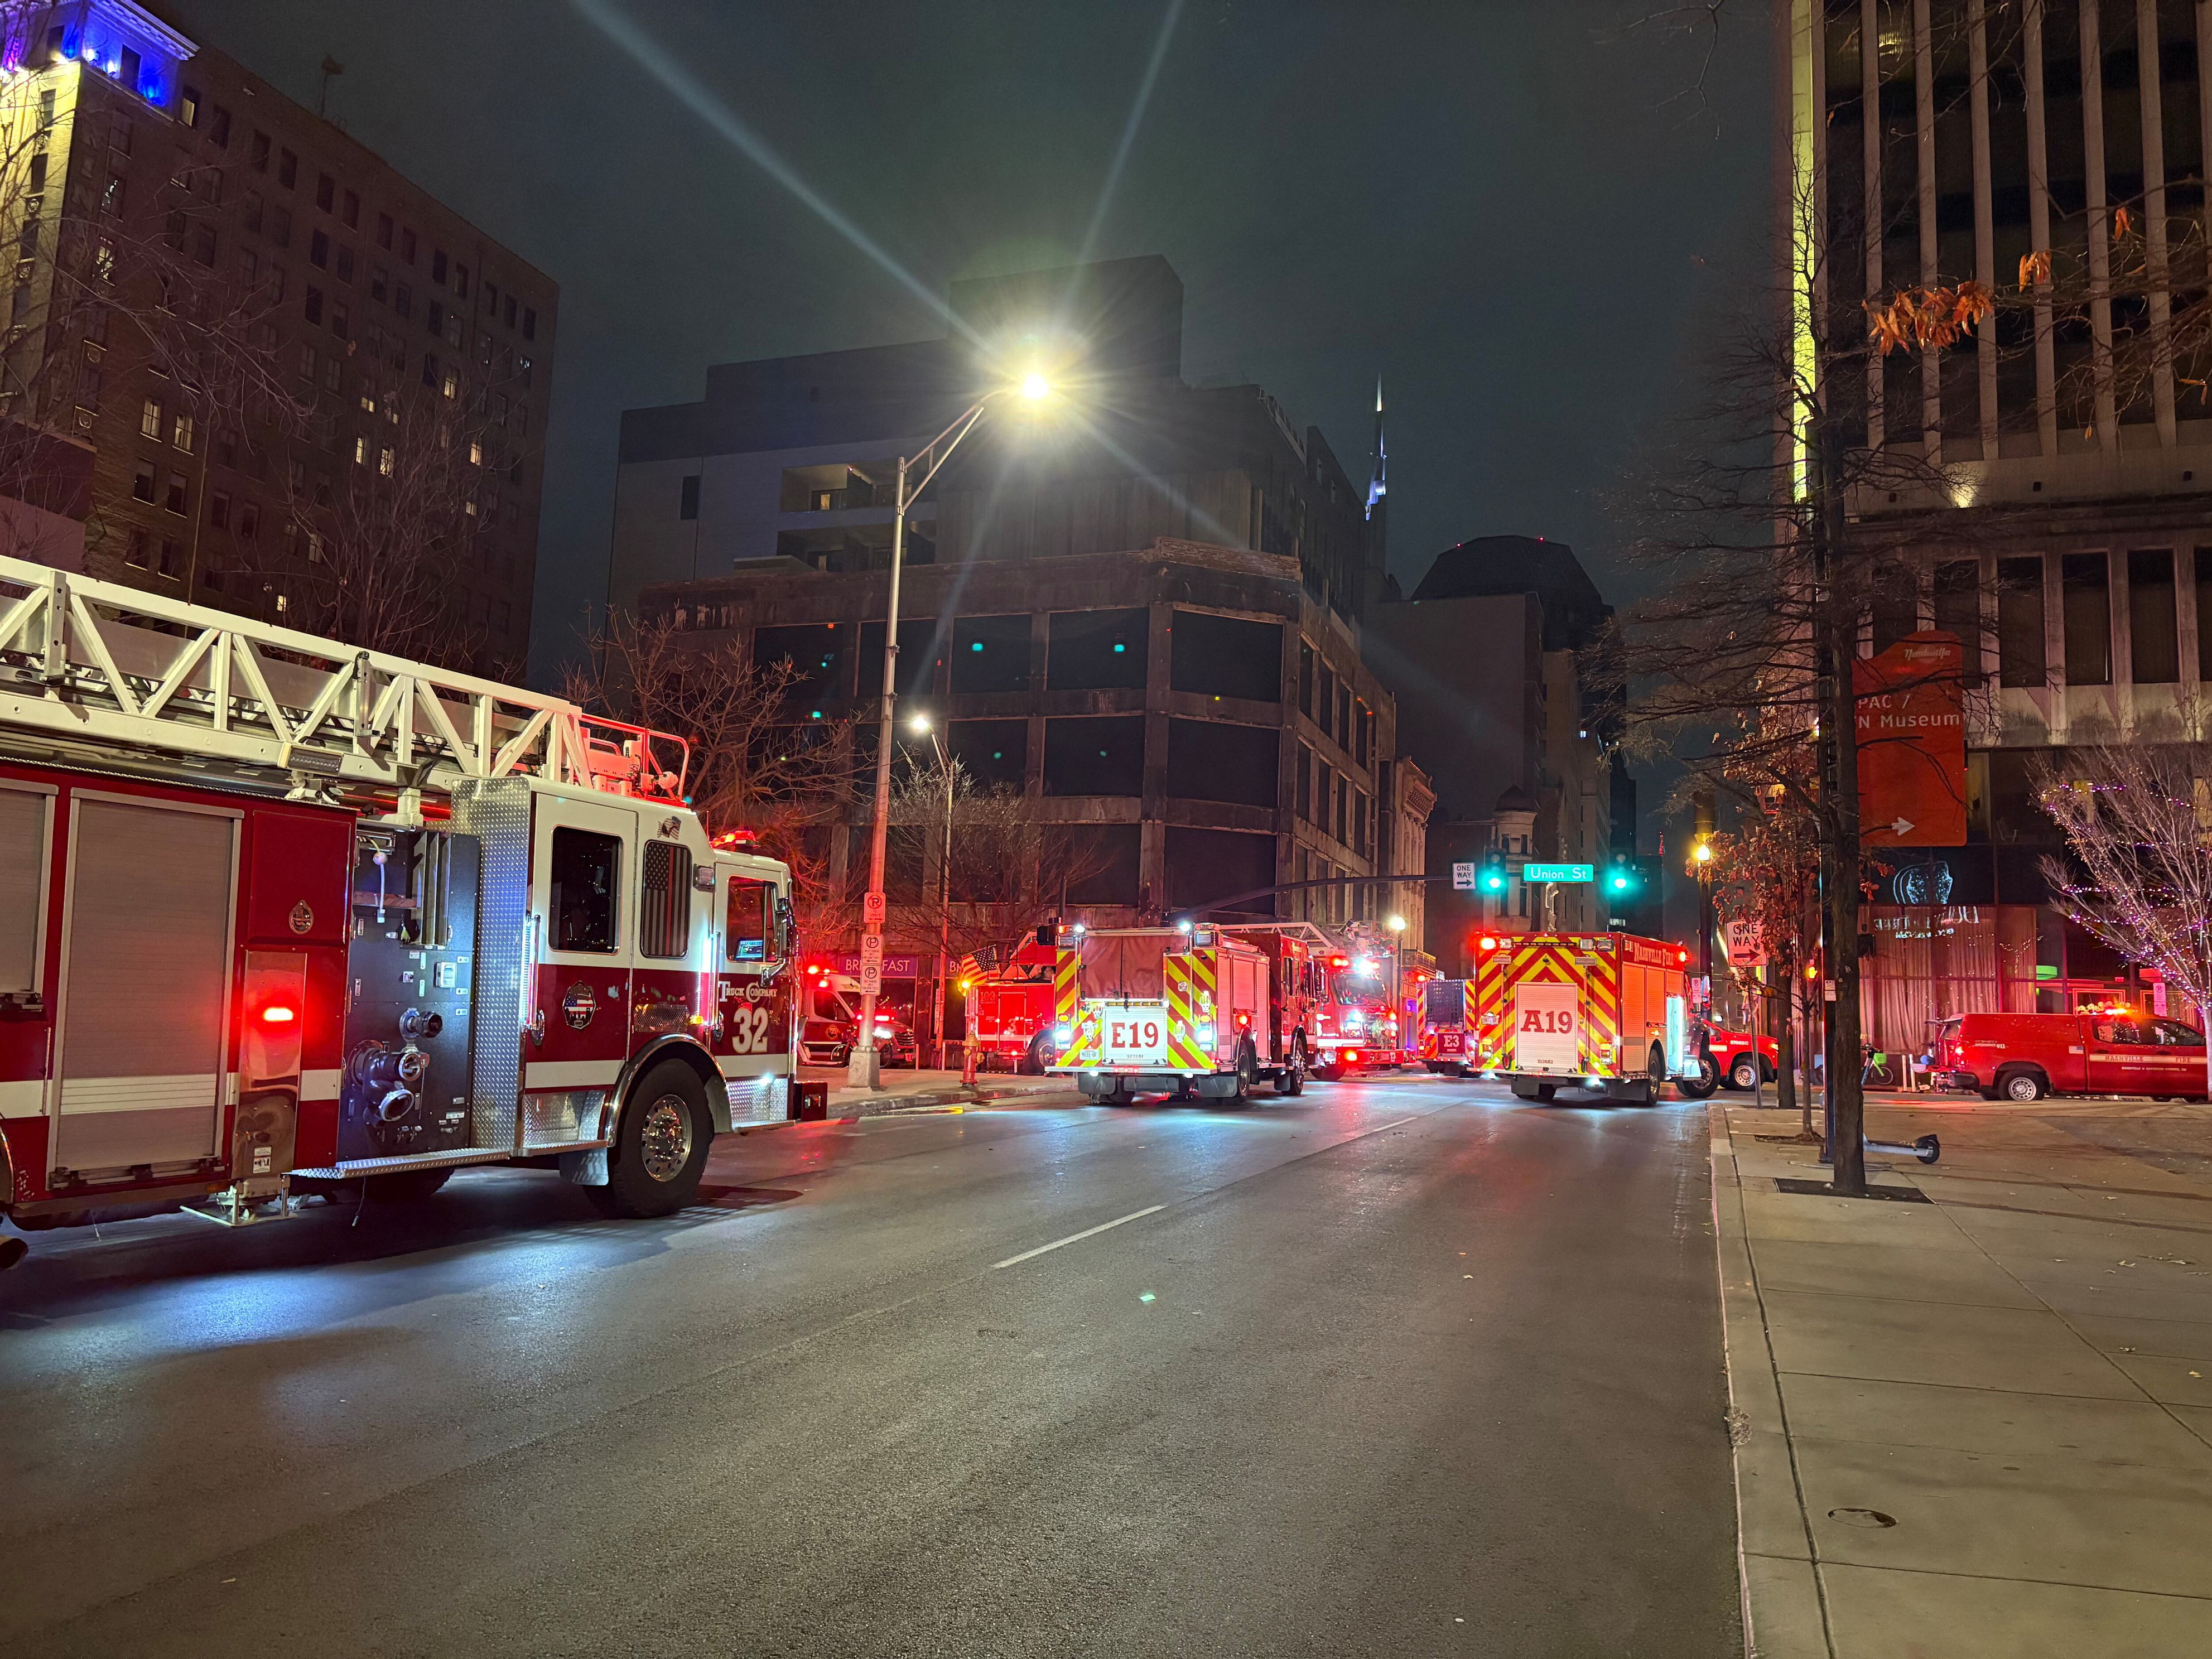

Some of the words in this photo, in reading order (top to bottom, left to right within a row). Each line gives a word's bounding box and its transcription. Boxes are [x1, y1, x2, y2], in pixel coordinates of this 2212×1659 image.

[1858, 695, 1892, 709] PAC
[1854, 715, 1870, 729] N
[1880, 713, 1960, 728] Museum
[1530, 867, 1564, 880] Union
[1572, 867, 1587, 880] St
[1733, 924, 1759, 935] ONE
[1733, 935, 1760, 947] WAY
[1634, 942, 1662, 964] NASHVILLE
[845, 959, 910, 972] BRFAST
[1521, 1010, 1573, 1034] A19
[731, 1007, 769, 1054] 32
[1111, 1022, 1159, 1048] E19
[1443, 1035, 1460, 1048] E3
